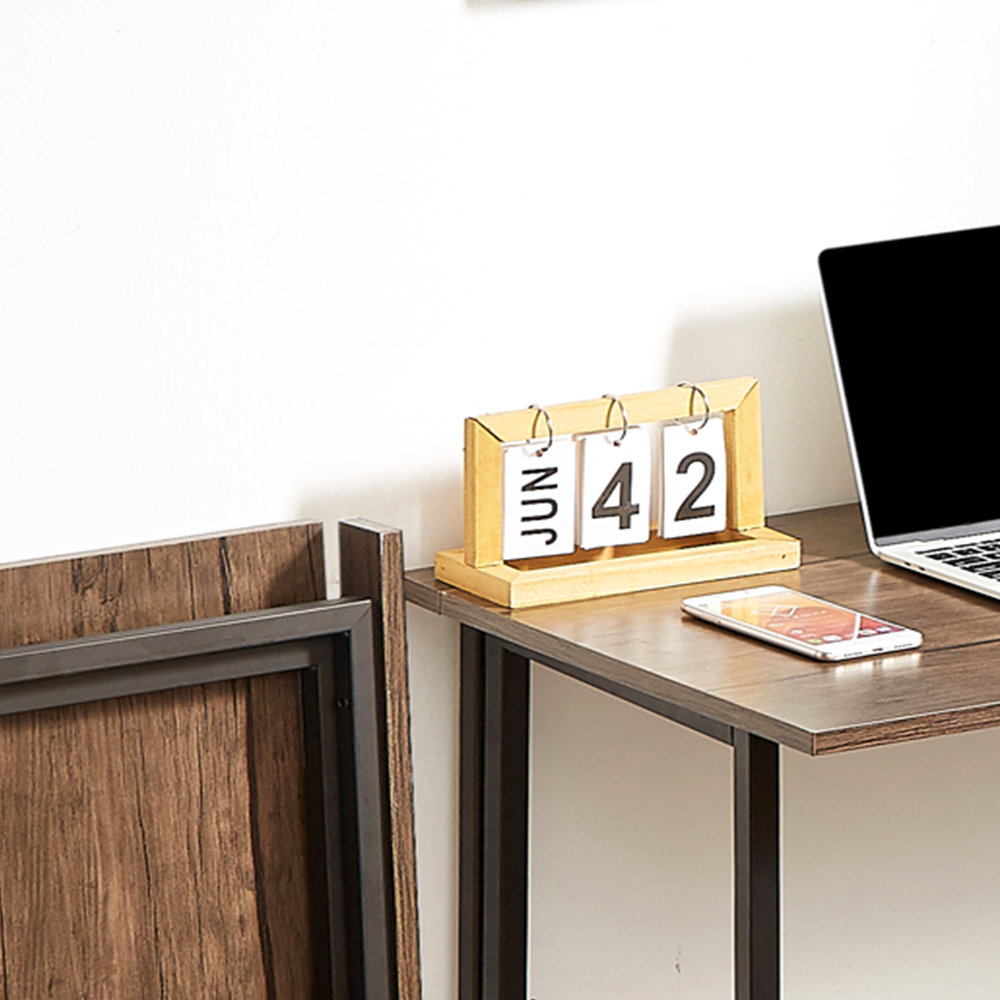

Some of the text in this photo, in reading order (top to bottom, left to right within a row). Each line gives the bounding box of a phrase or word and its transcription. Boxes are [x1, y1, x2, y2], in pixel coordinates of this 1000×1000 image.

[520, 466, 559, 545] JUN
[591, 451, 716, 530] 4 2
